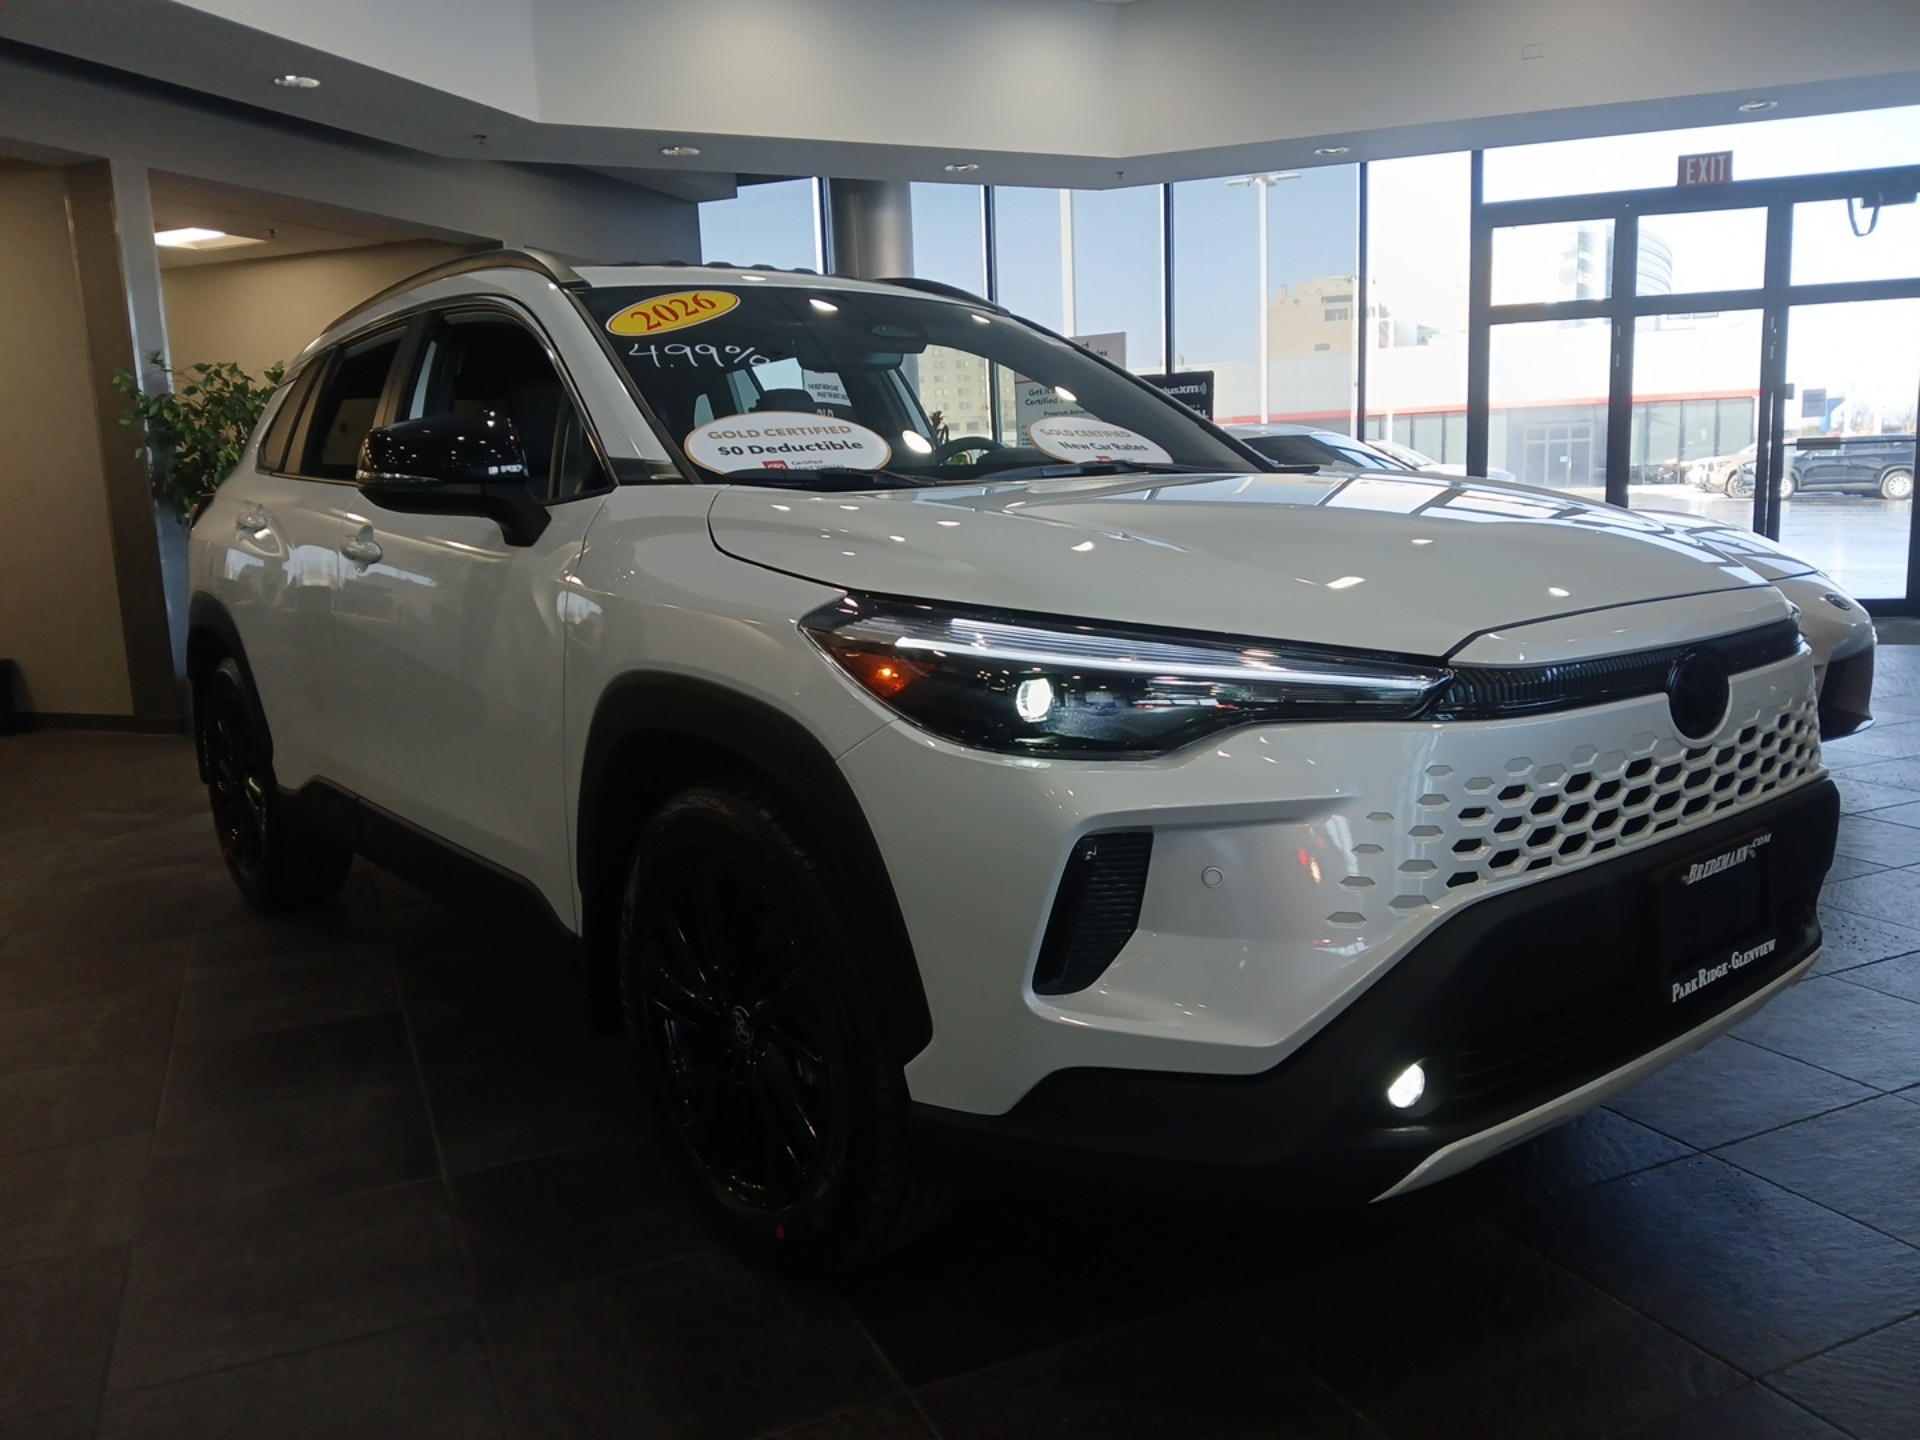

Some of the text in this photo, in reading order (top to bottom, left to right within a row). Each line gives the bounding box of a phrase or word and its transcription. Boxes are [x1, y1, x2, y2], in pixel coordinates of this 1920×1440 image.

[1686, 156, 1728, 184] EXIT
[631, 292, 717, 331] 2026
[628, 343, 771, 369] 4.99%
[1028, 388, 1043, 396] Get
[1025, 397, 1058, 406] Certified
[708, 425, 852, 440] GOLD CERTIFIED
[1040, 428, 1075, 437] GOLD
[1075, 429, 1132, 438] CERTIFIED
[718, 439, 863, 456] $0 Deductible
[1058, 441, 1149, 452] New Car Rates
[1672, 980, 1698, 1003] PARK
